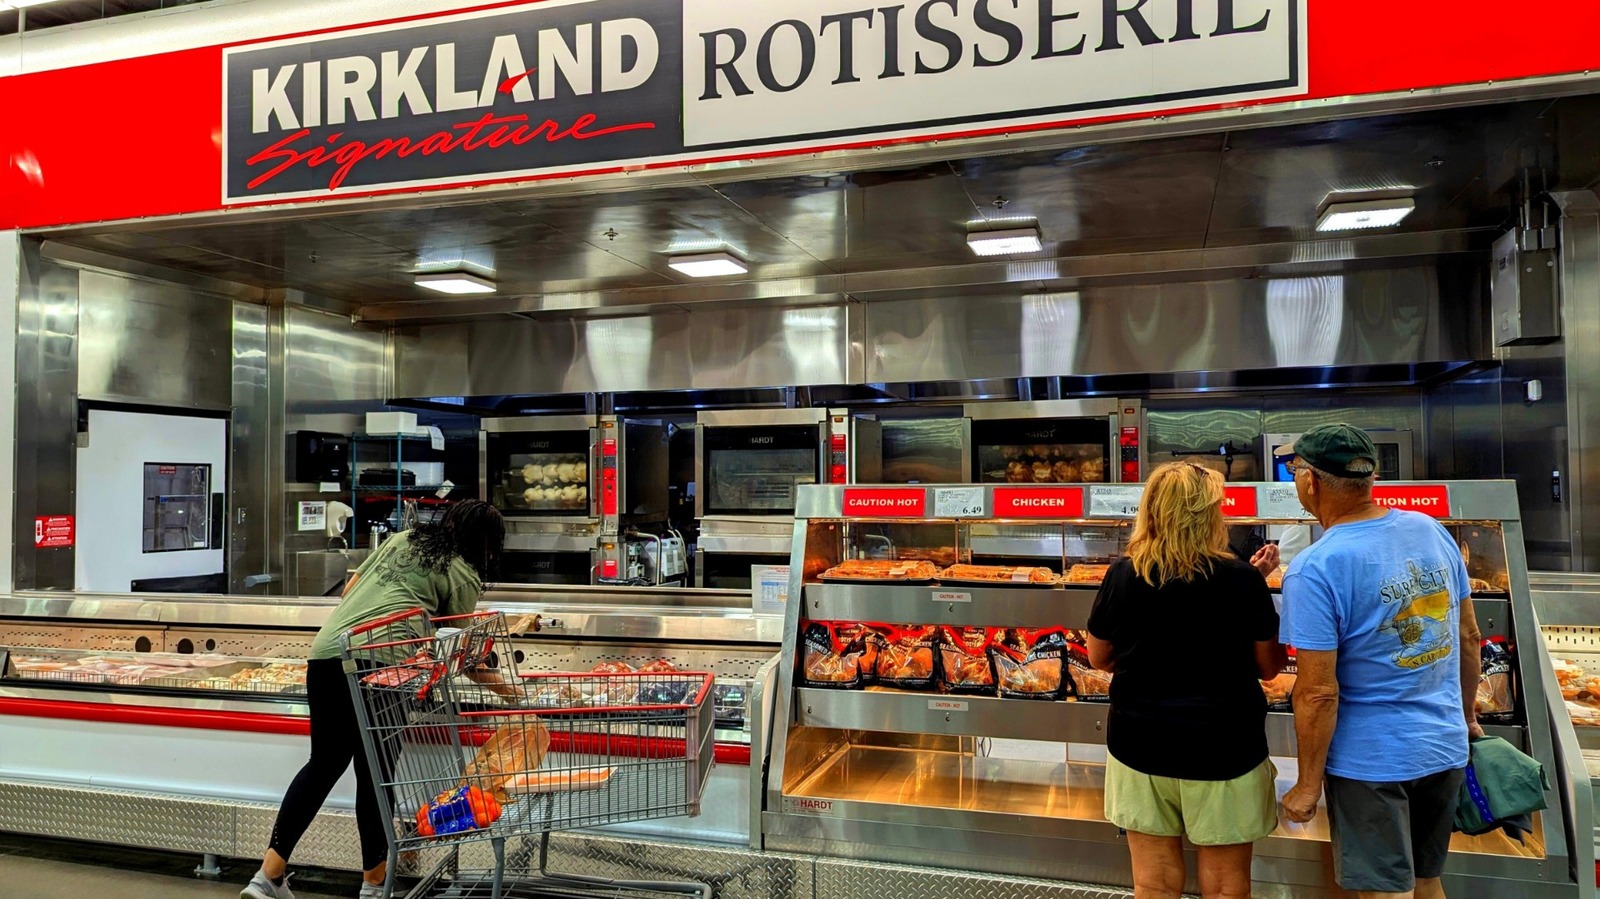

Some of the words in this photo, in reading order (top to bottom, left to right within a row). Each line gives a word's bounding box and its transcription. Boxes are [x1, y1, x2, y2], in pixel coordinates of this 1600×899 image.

[252, 17, 660, 134] KIRKLAND
[246, 113, 656, 191] Signature
[848, 498, 894, 507] CAUTION
[896, 498, 919, 507] HOT
[1012, 498, 1065, 507] CHICKEN
[1374, 497, 1407, 506] TION
[1411, 497, 1439, 506] HOT
[962, 506, 982, 515] 6.49
[805, 639, 832, 657] SEASONED
[1037, 649, 1061, 659] CHICKEN
[800, 799, 833, 810] HARDT
